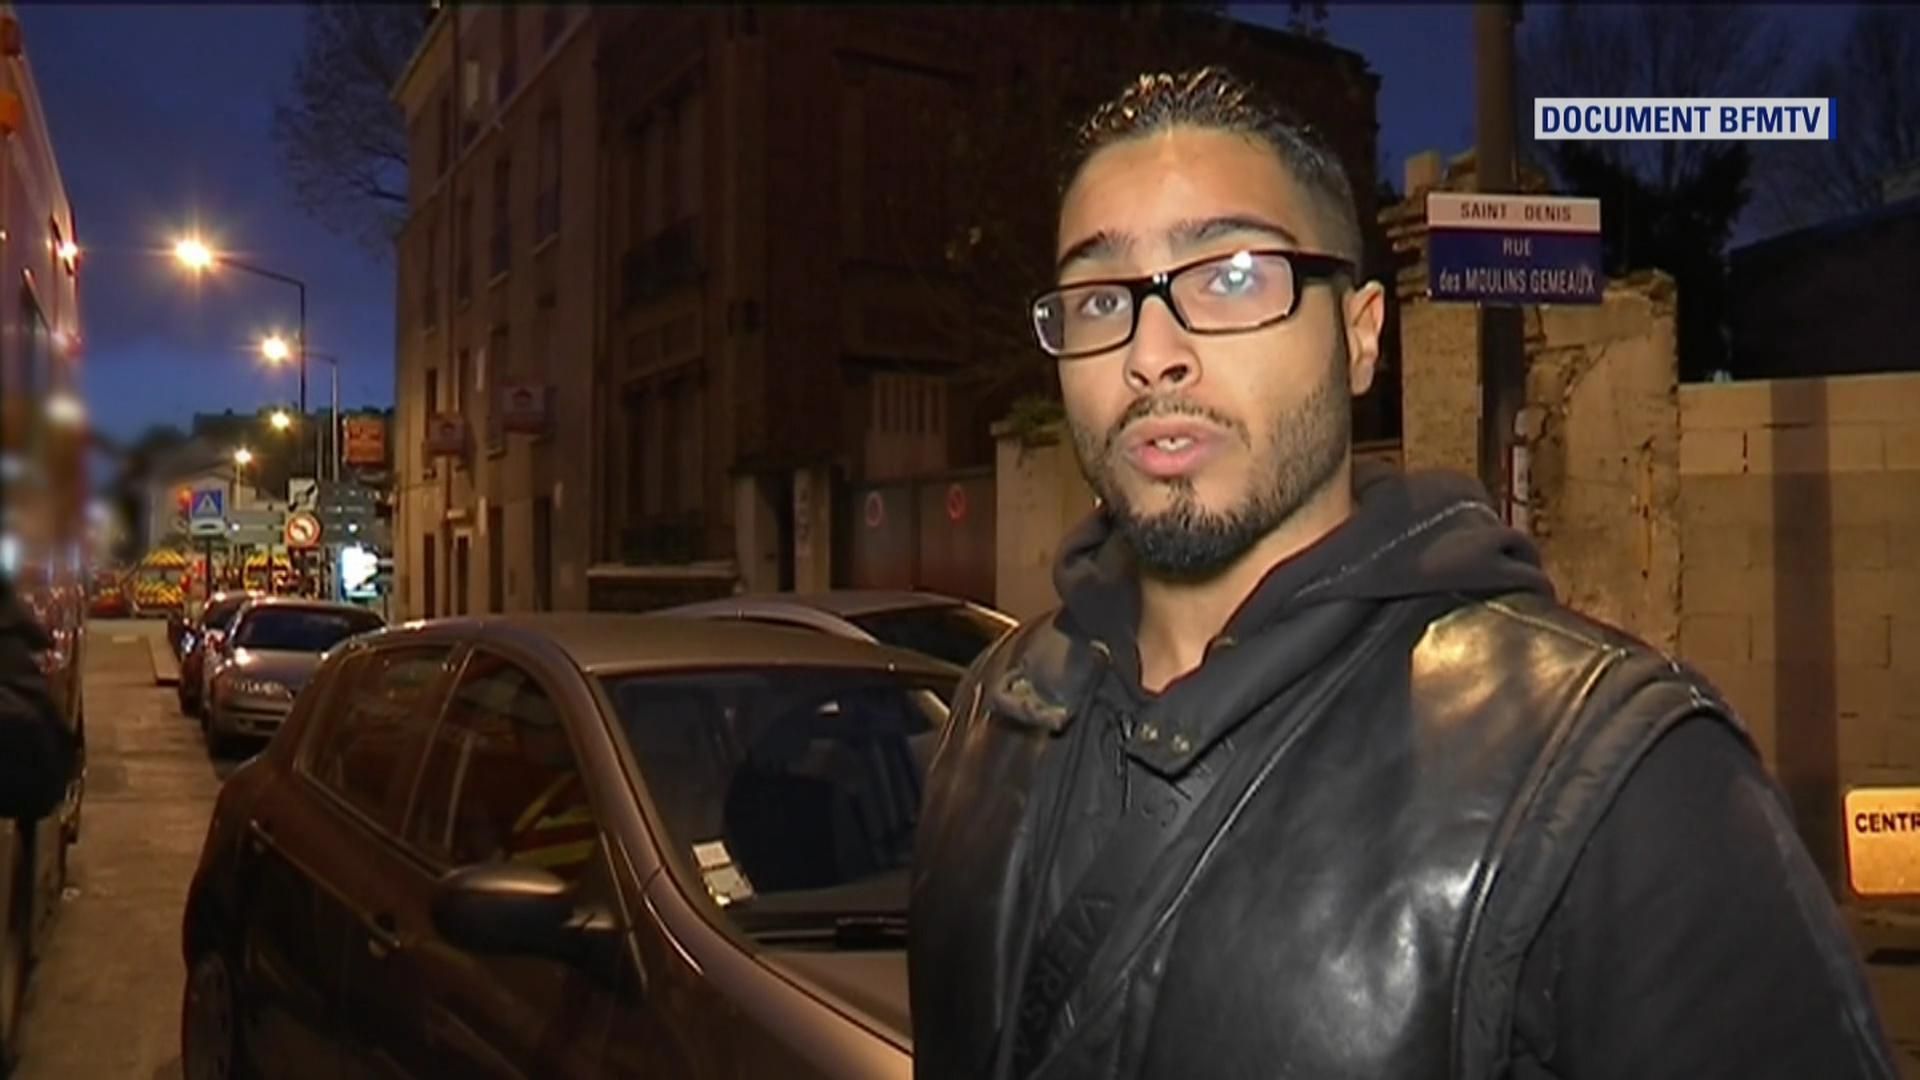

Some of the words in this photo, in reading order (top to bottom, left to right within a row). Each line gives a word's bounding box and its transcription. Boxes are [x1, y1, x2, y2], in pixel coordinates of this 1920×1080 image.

[1460, 202, 1507, 220] SAINT
[1524, 204, 1572, 222] DENIS
[1502, 238, 1532, 256] RUE
[1439, 267, 1461, 292] des
[1465, 267, 1528, 294] MOULINS
